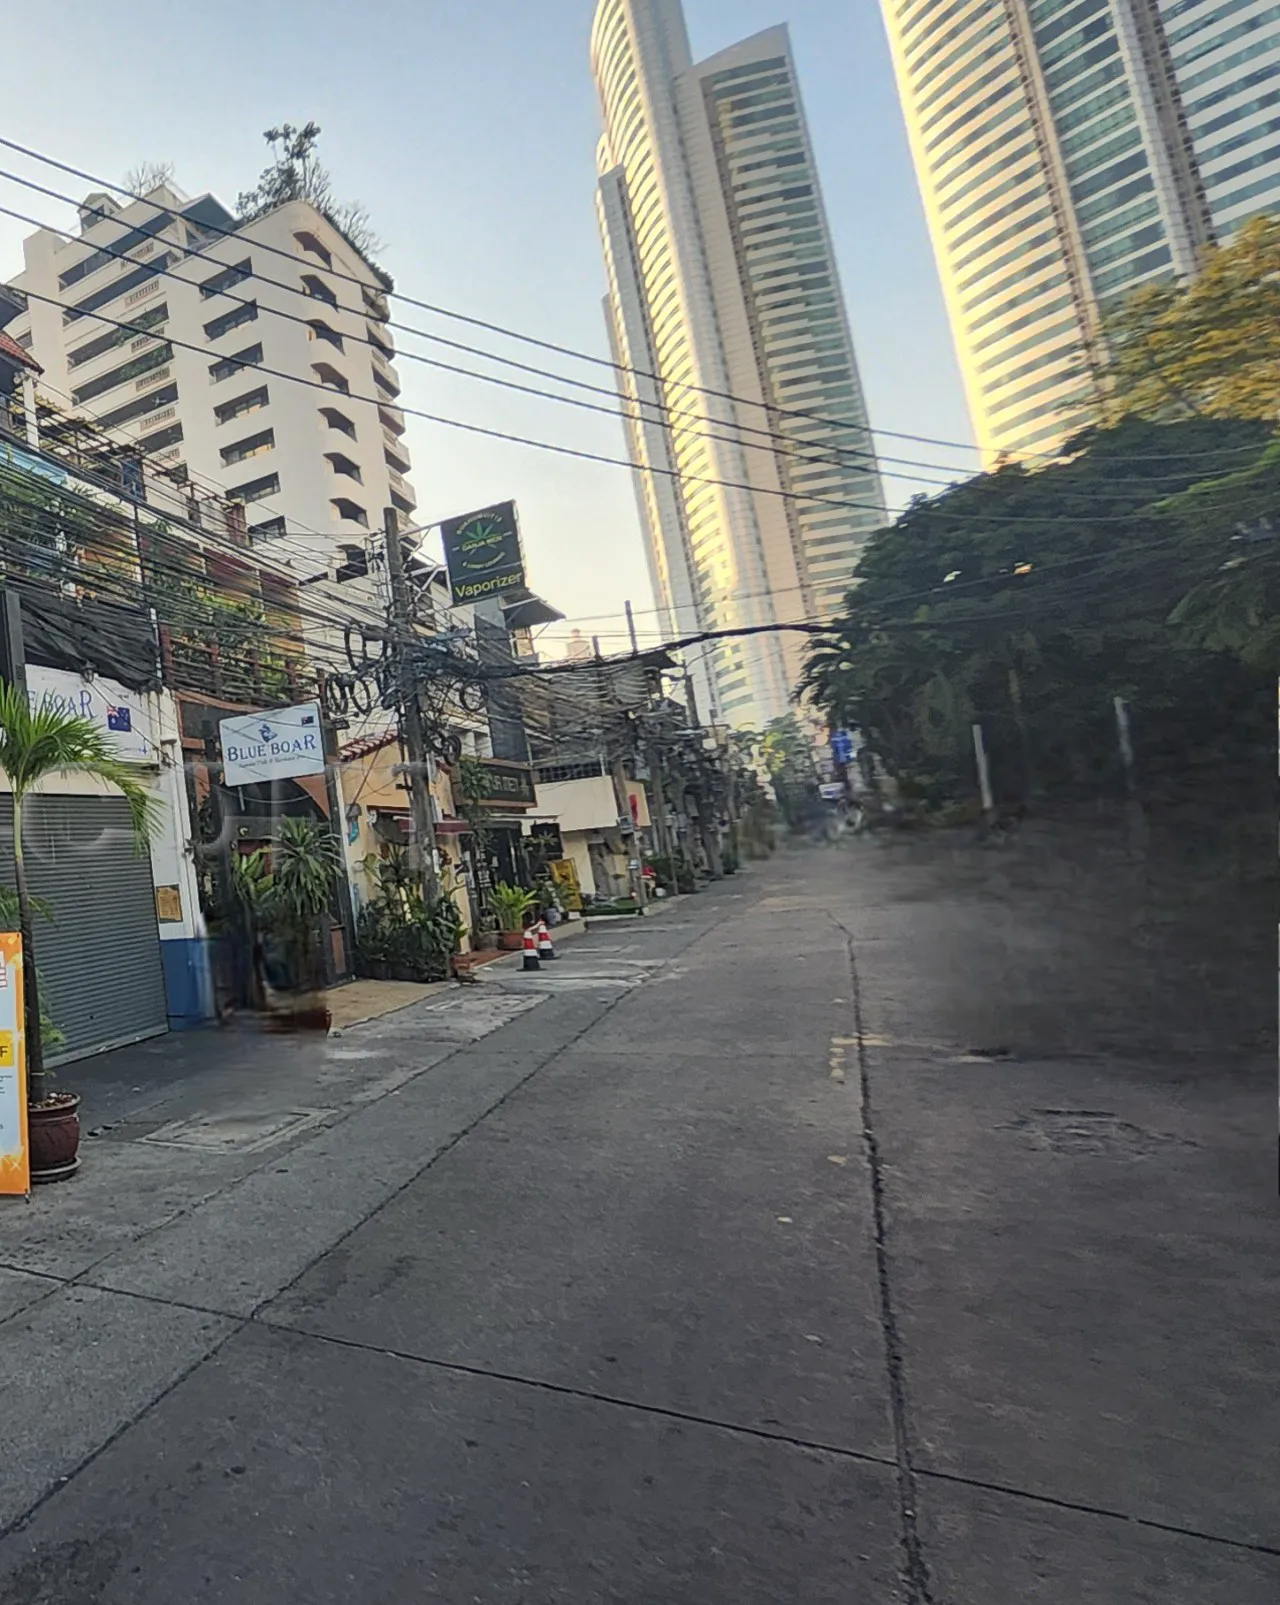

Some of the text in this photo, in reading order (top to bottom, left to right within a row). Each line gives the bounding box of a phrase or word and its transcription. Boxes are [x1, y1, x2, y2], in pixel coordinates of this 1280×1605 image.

[455, 572, 523, 598] Vaporizer
[227, 744, 267, 762] BLUE
[271, 733, 318, 756] BOAR
